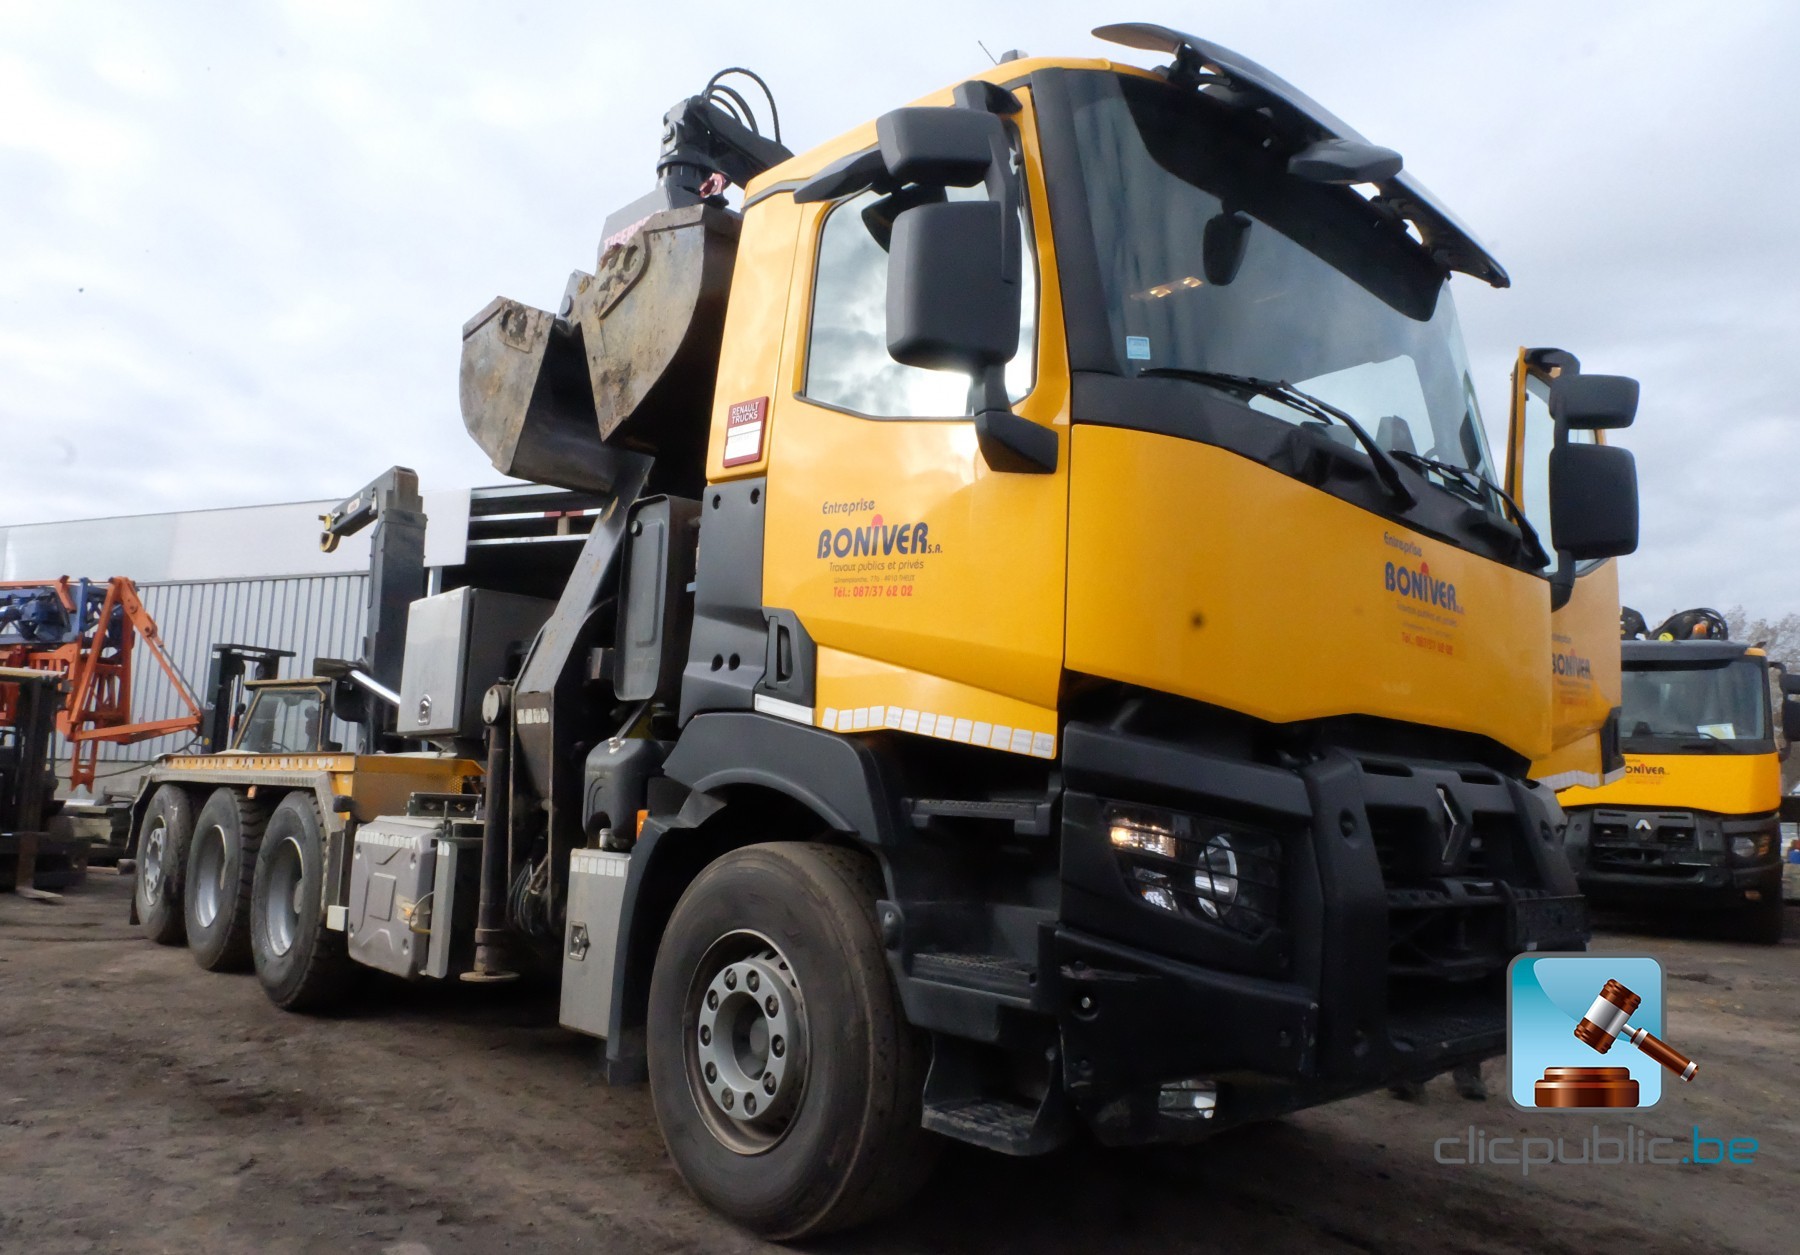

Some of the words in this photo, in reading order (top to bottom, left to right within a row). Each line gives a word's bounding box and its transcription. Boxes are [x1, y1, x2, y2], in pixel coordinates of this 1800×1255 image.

[732, 401, 760, 416] RENAULT
[732, 410, 758, 424] TRUCKS
[822, 498, 875, 516] Entreprise
[817, 514, 929, 559] BONIVER
[927, 543, 943, 554] S.A.
[829, 561, 856, 572] Travaux
[857, 560, 885, 573] publics
[887, 561, 896, 570] et
[898, 559, 924, 572] privés
[853, 585, 883, 598] 087/37
[886, 584, 898, 597] 62
[900, 584, 913, 597] 02
[1385, 561, 1457, 612] BONIVER
[1625, 763, 1665, 774] ONIVER
